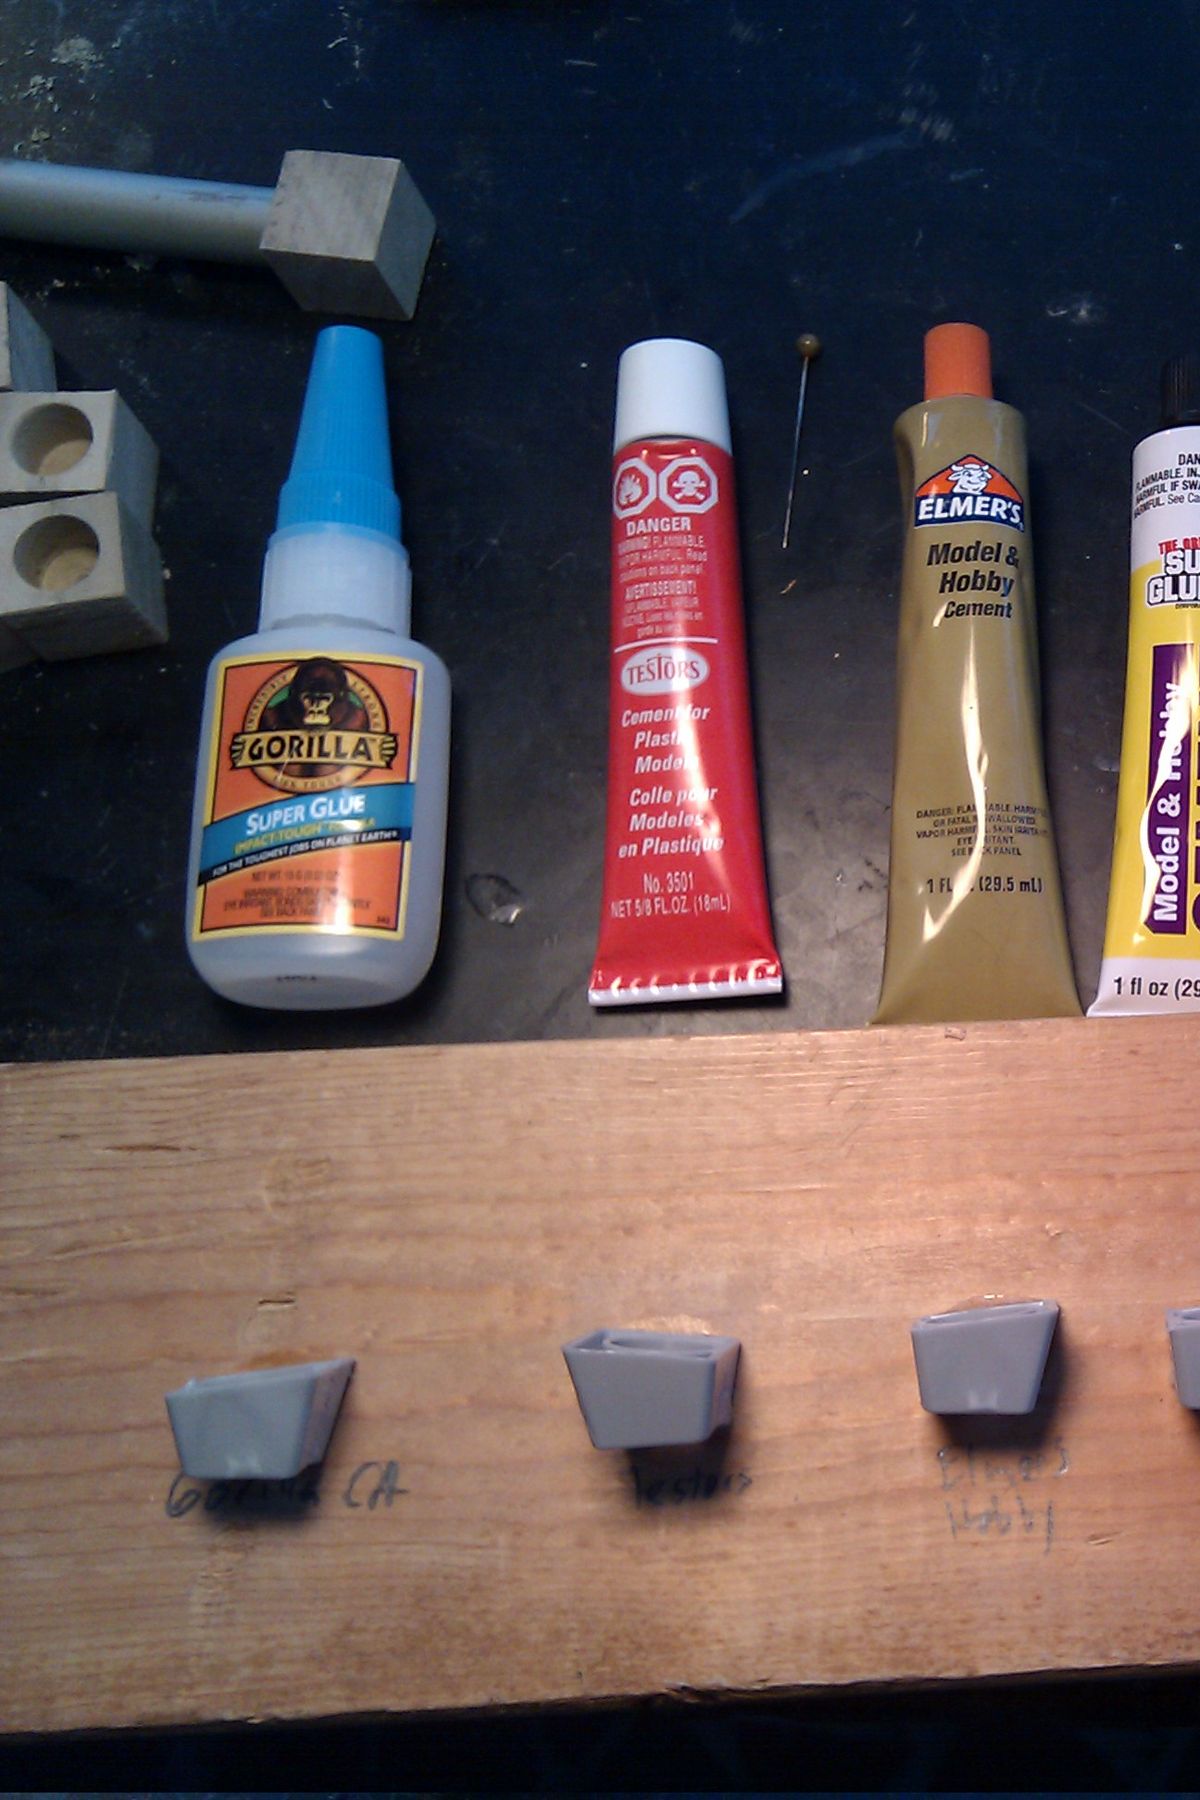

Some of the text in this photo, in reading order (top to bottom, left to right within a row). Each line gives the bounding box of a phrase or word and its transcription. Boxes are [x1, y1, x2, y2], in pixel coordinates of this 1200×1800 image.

[1136, 482, 1168, 503] HARMFUL
[1170, 481, 1180, 491] IF
[1167, 493, 1185, 505] See
[918, 496, 1021, 524] ELMER'S
[626, 516, 692, 536] DANGER
[926, 540, 1020, 569] Model &
[1158, 539, 1178, 555] THE
[938, 569, 1015, 597] Hobby
[944, 601, 1013, 619] Cement
[626, 653, 701, 685] TESTORS
[248, 734, 374, 762] GORILLA
[634, 730, 692, 750] Plast
[634, 753, 699, 775] Model
[629, 785, 673, 807] Colle
[1153, 683, 1184, 922] Model & Hbby
[246, 804, 305, 836] SUPER
[310, 794, 366, 819] GLUE
[956, 803, 1011, 815] FLAABLE
[326, 834, 361, 848] PLANET
[618, 834, 725, 858] en Plastique
[643, 871, 694, 894] No. 3501
[927, 878, 934, 893] 1
[978, 876, 1015, 892] (29.5
[1019, 878, 1043, 893] mL)
[610, 892, 731, 918] NET 5/8 (18mL)
[1113, 977, 1122, 995] 1
[1130, 977, 1142, 995] fl
[1148, 981, 1169, 996] oz
[342, 1460, 410, 1510] CA
